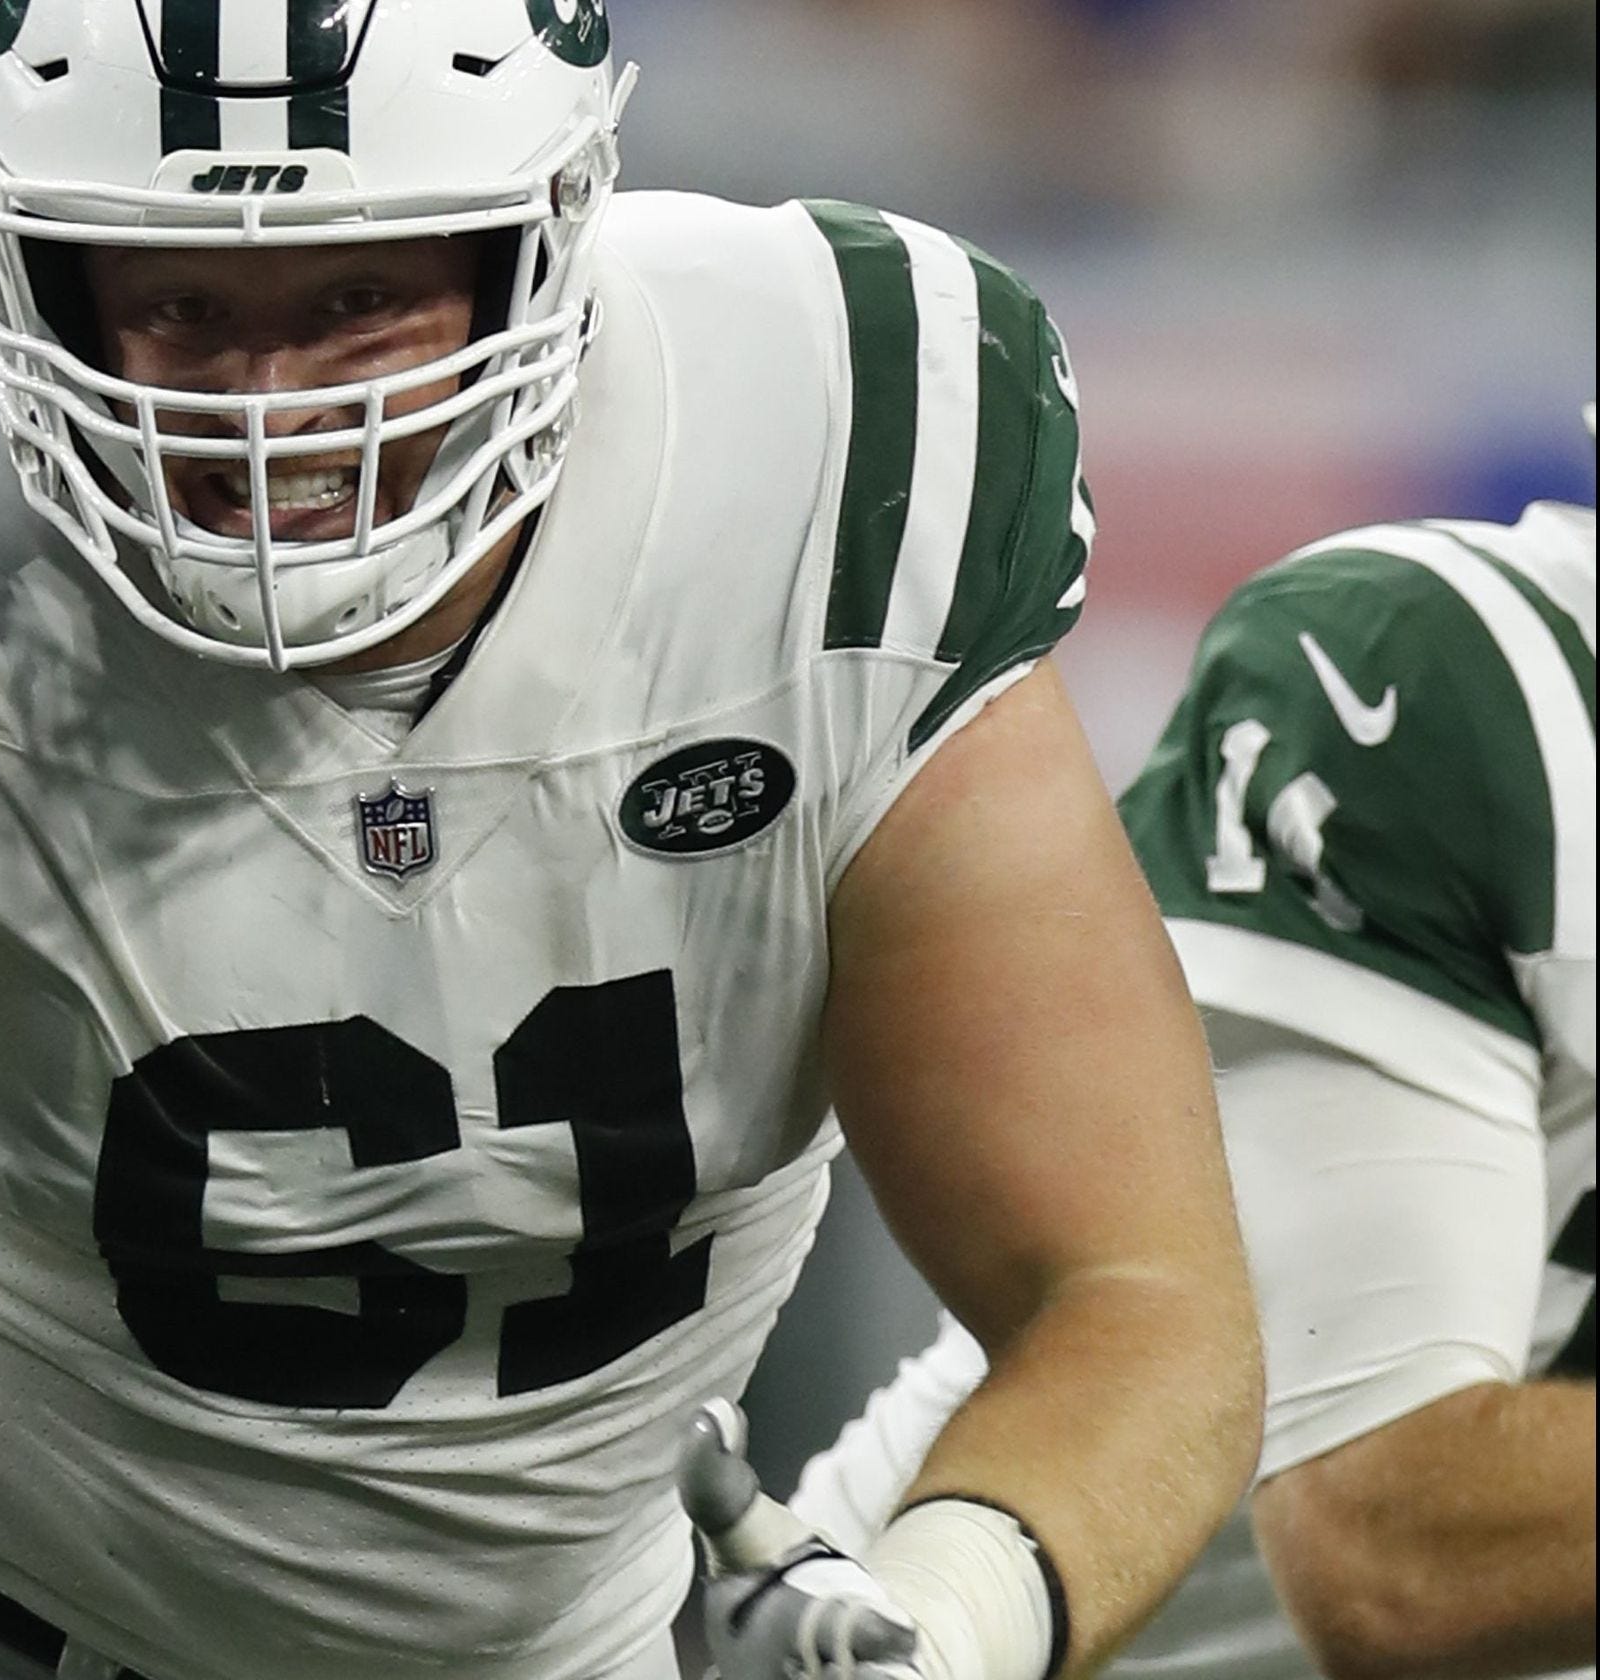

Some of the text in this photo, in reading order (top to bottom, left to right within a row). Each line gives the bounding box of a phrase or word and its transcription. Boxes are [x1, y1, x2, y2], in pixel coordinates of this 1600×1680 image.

[191, 165, 308, 193] JETS
[643, 768, 765, 828] JETS
[369, 827, 428, 866] NFL
[93, 968, 715, 1410] 61
